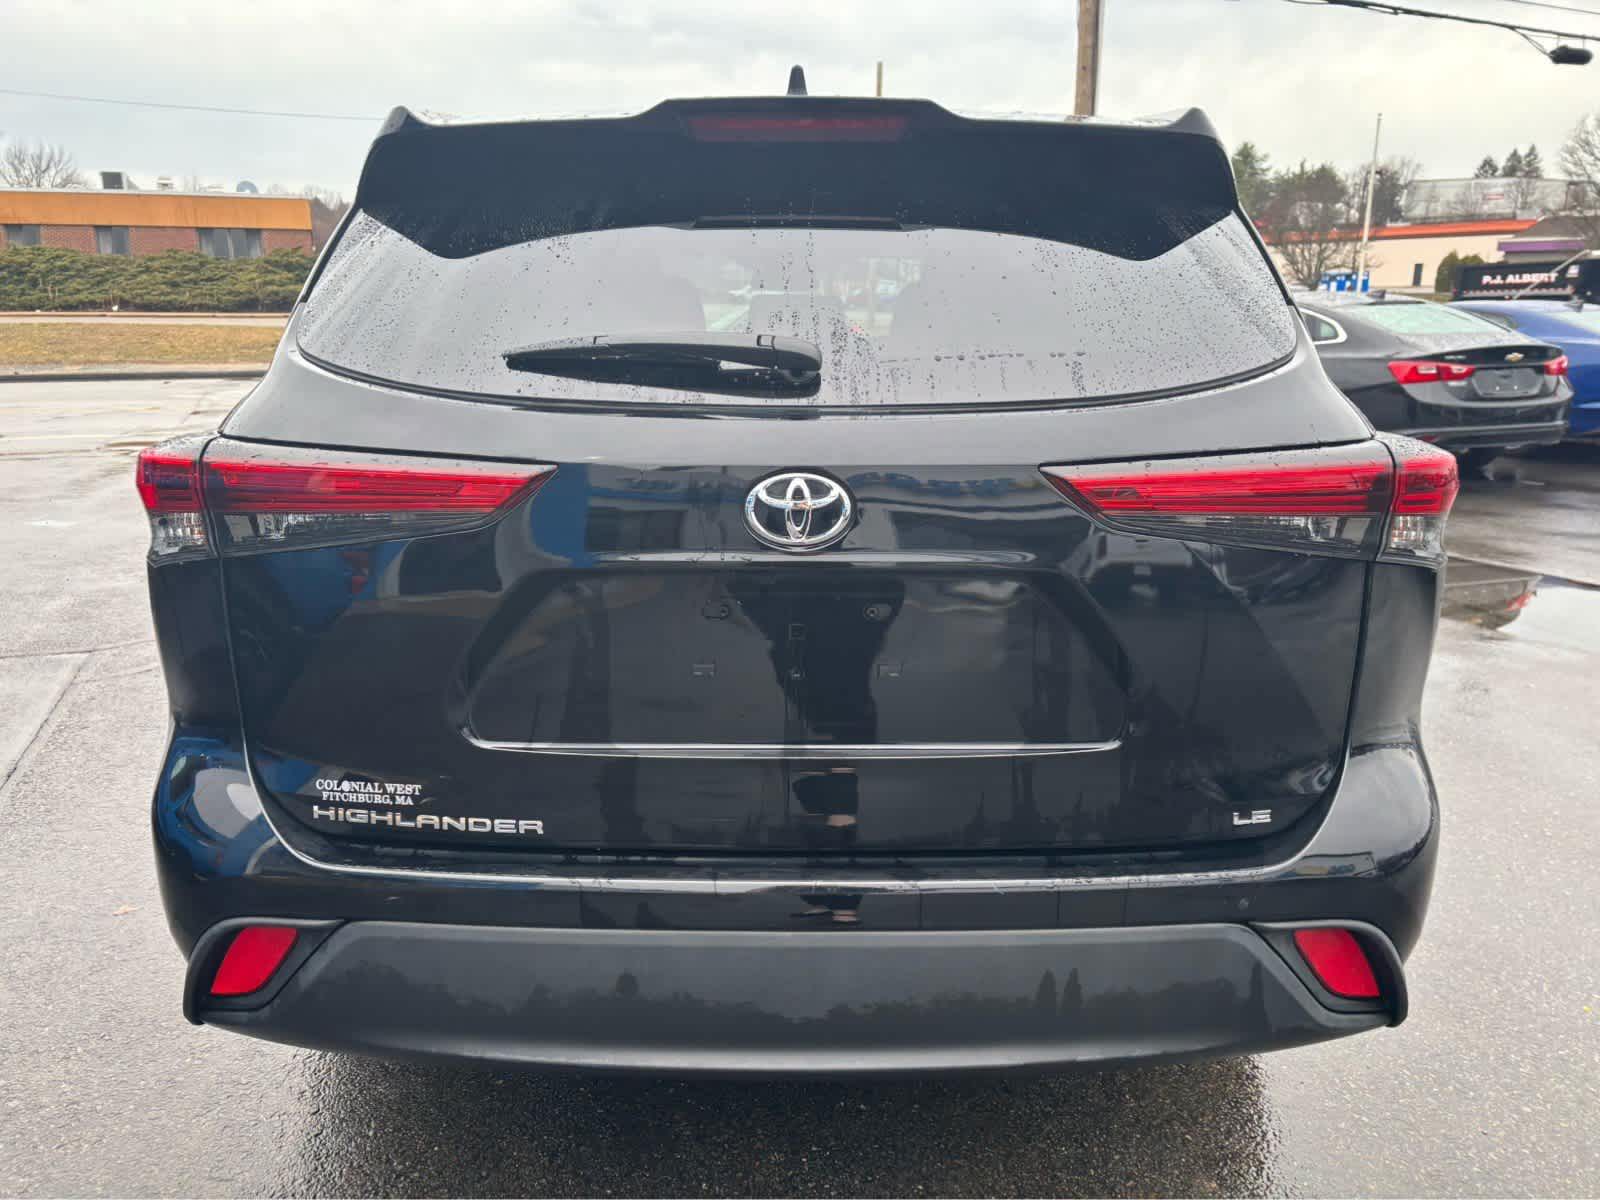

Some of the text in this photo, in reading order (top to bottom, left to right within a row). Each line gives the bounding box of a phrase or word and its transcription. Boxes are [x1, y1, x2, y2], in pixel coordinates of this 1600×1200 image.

[1505, 272, 1559, 285] ALBERT
[315, 779, 422, 796] COLONIAL WEST
[322, 791, 414, 806] FITCHBURG, MA
[312, 805, 544, 835] HIGHLANDER
[1232, 809, 1272, 825] LE
